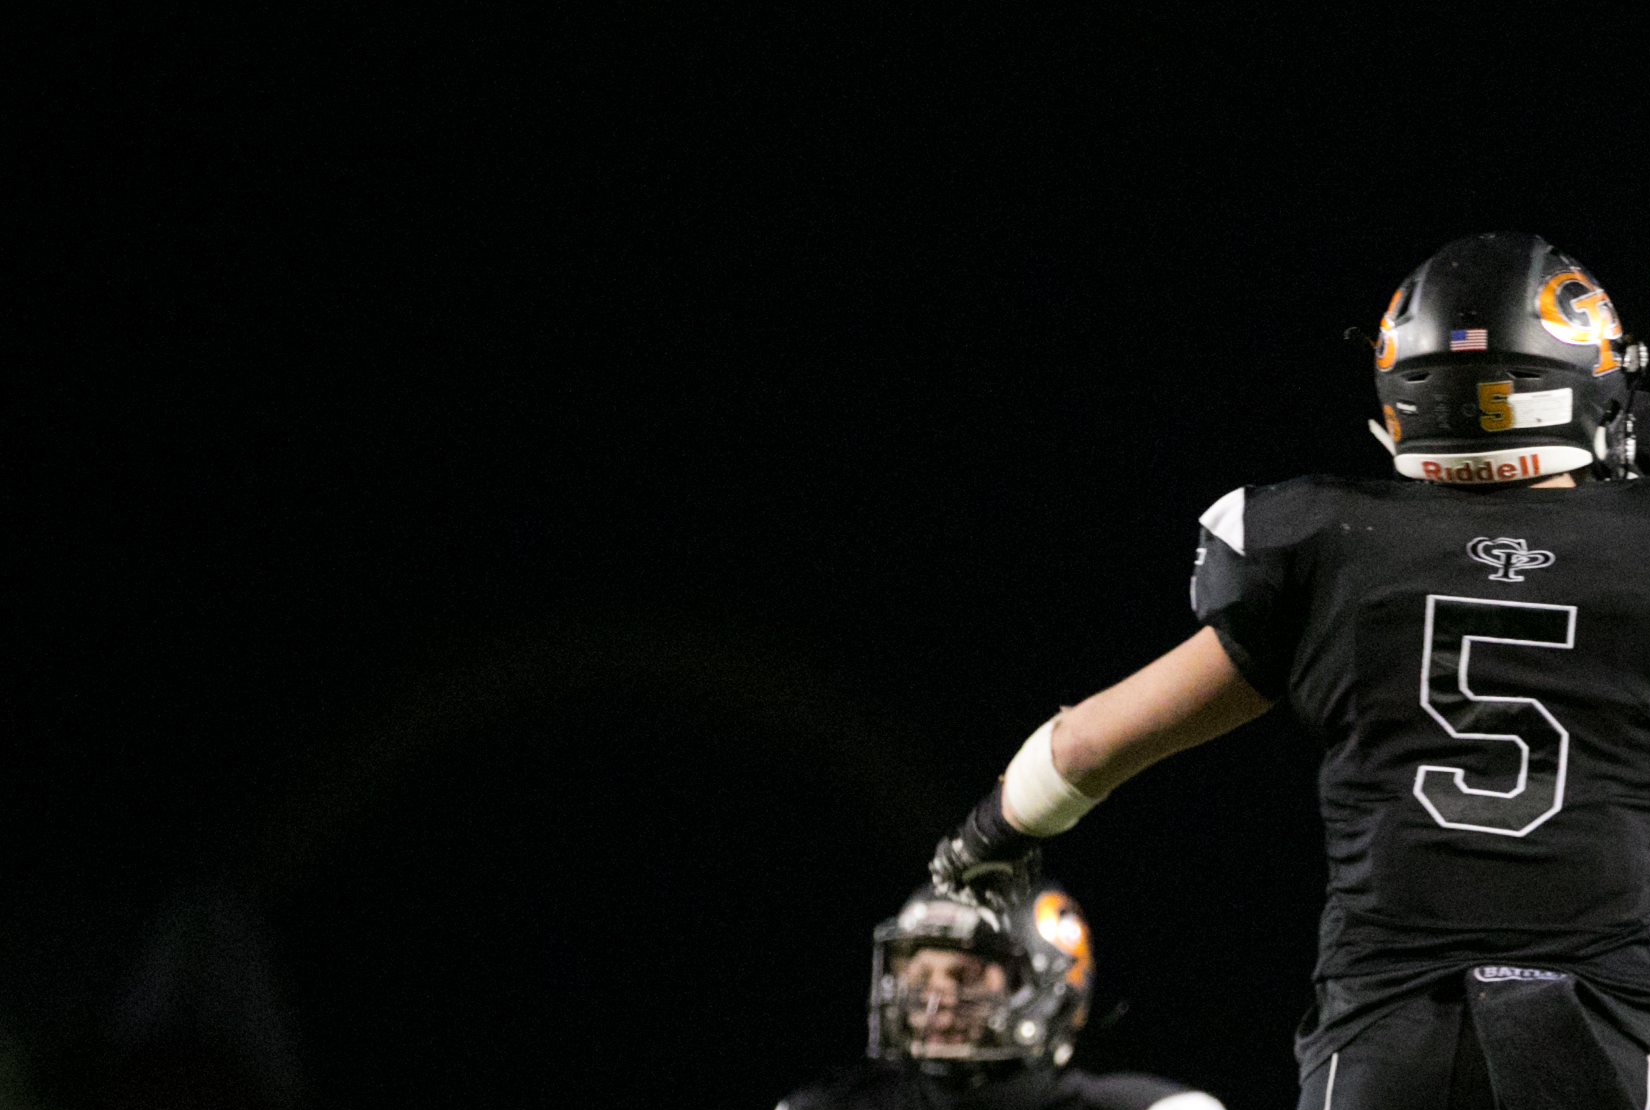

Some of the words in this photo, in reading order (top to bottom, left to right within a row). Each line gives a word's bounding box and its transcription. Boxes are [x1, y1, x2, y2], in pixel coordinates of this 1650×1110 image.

[1478, 381, 1513, 432] 5
[1421, 454, 1540, 482] Riddell
[1413, 594, 1578, 837] 5
